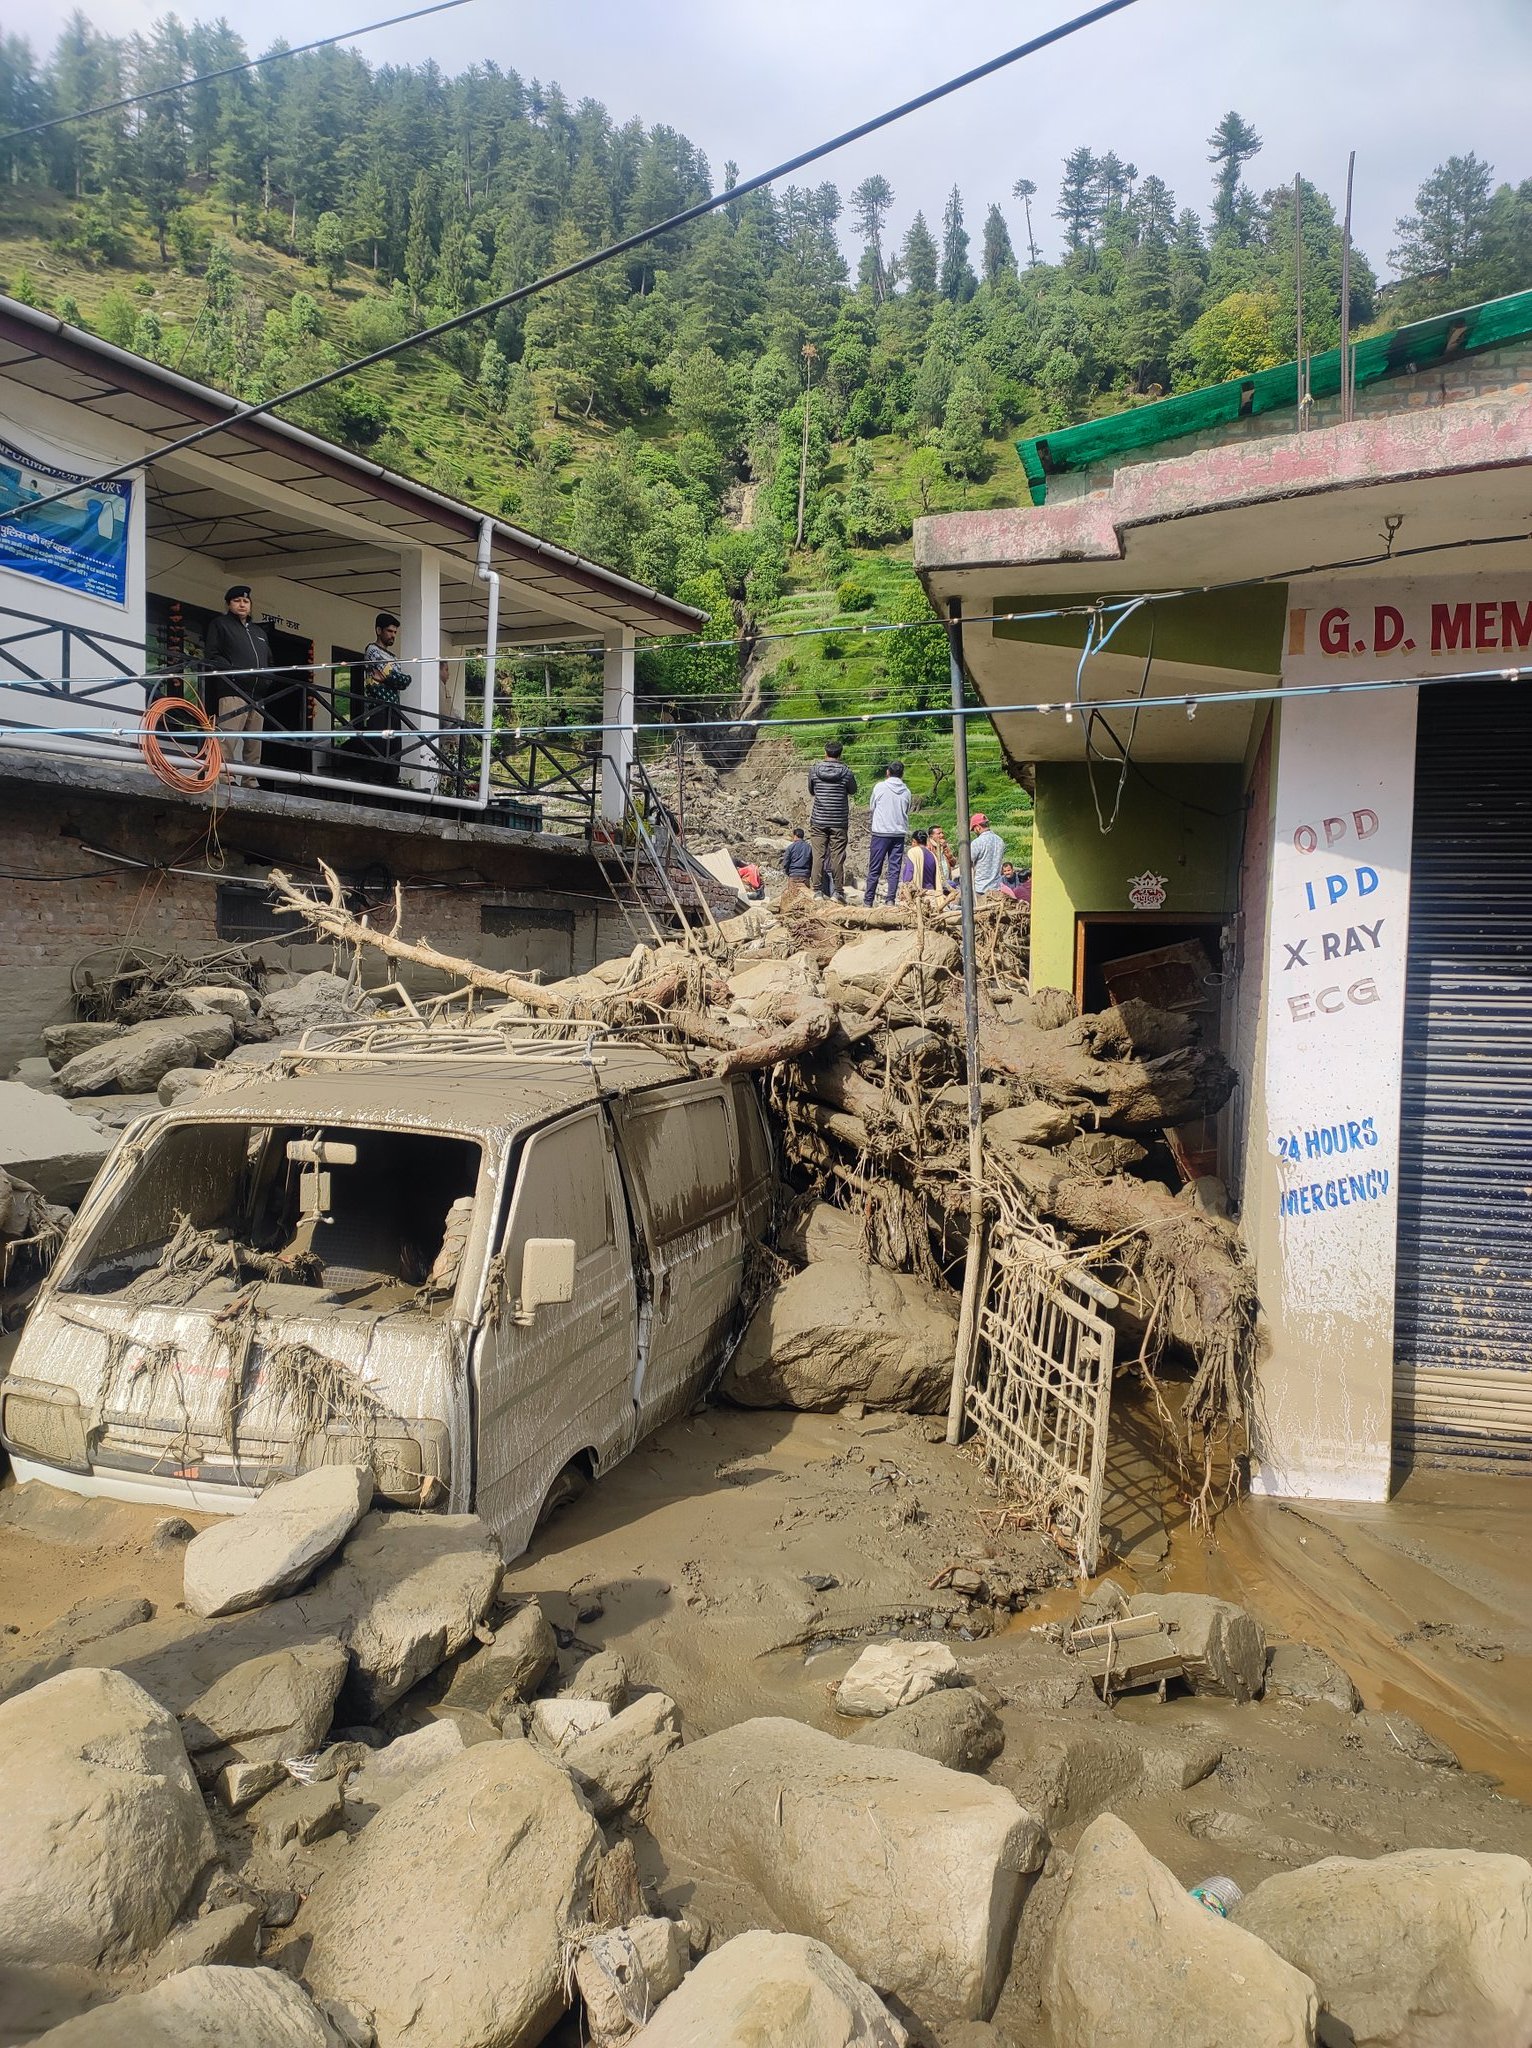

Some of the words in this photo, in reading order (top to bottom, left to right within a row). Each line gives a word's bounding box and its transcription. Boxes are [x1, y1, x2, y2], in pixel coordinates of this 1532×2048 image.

[1319, 605, 1416, 657] G.D.
[1431, 600, 1532, 655] MEM
[1293, 808, 1380, 855] OPD
[1305, 865, 1380, 911] IPD
[1286, 977, 1381, 1023] ECG
[1277, 1135, 1301, 1164] 24
[1305, 1116, 1379, 1159] HOURS
[1280, 1168, 1389, 1218] MERGENCY
